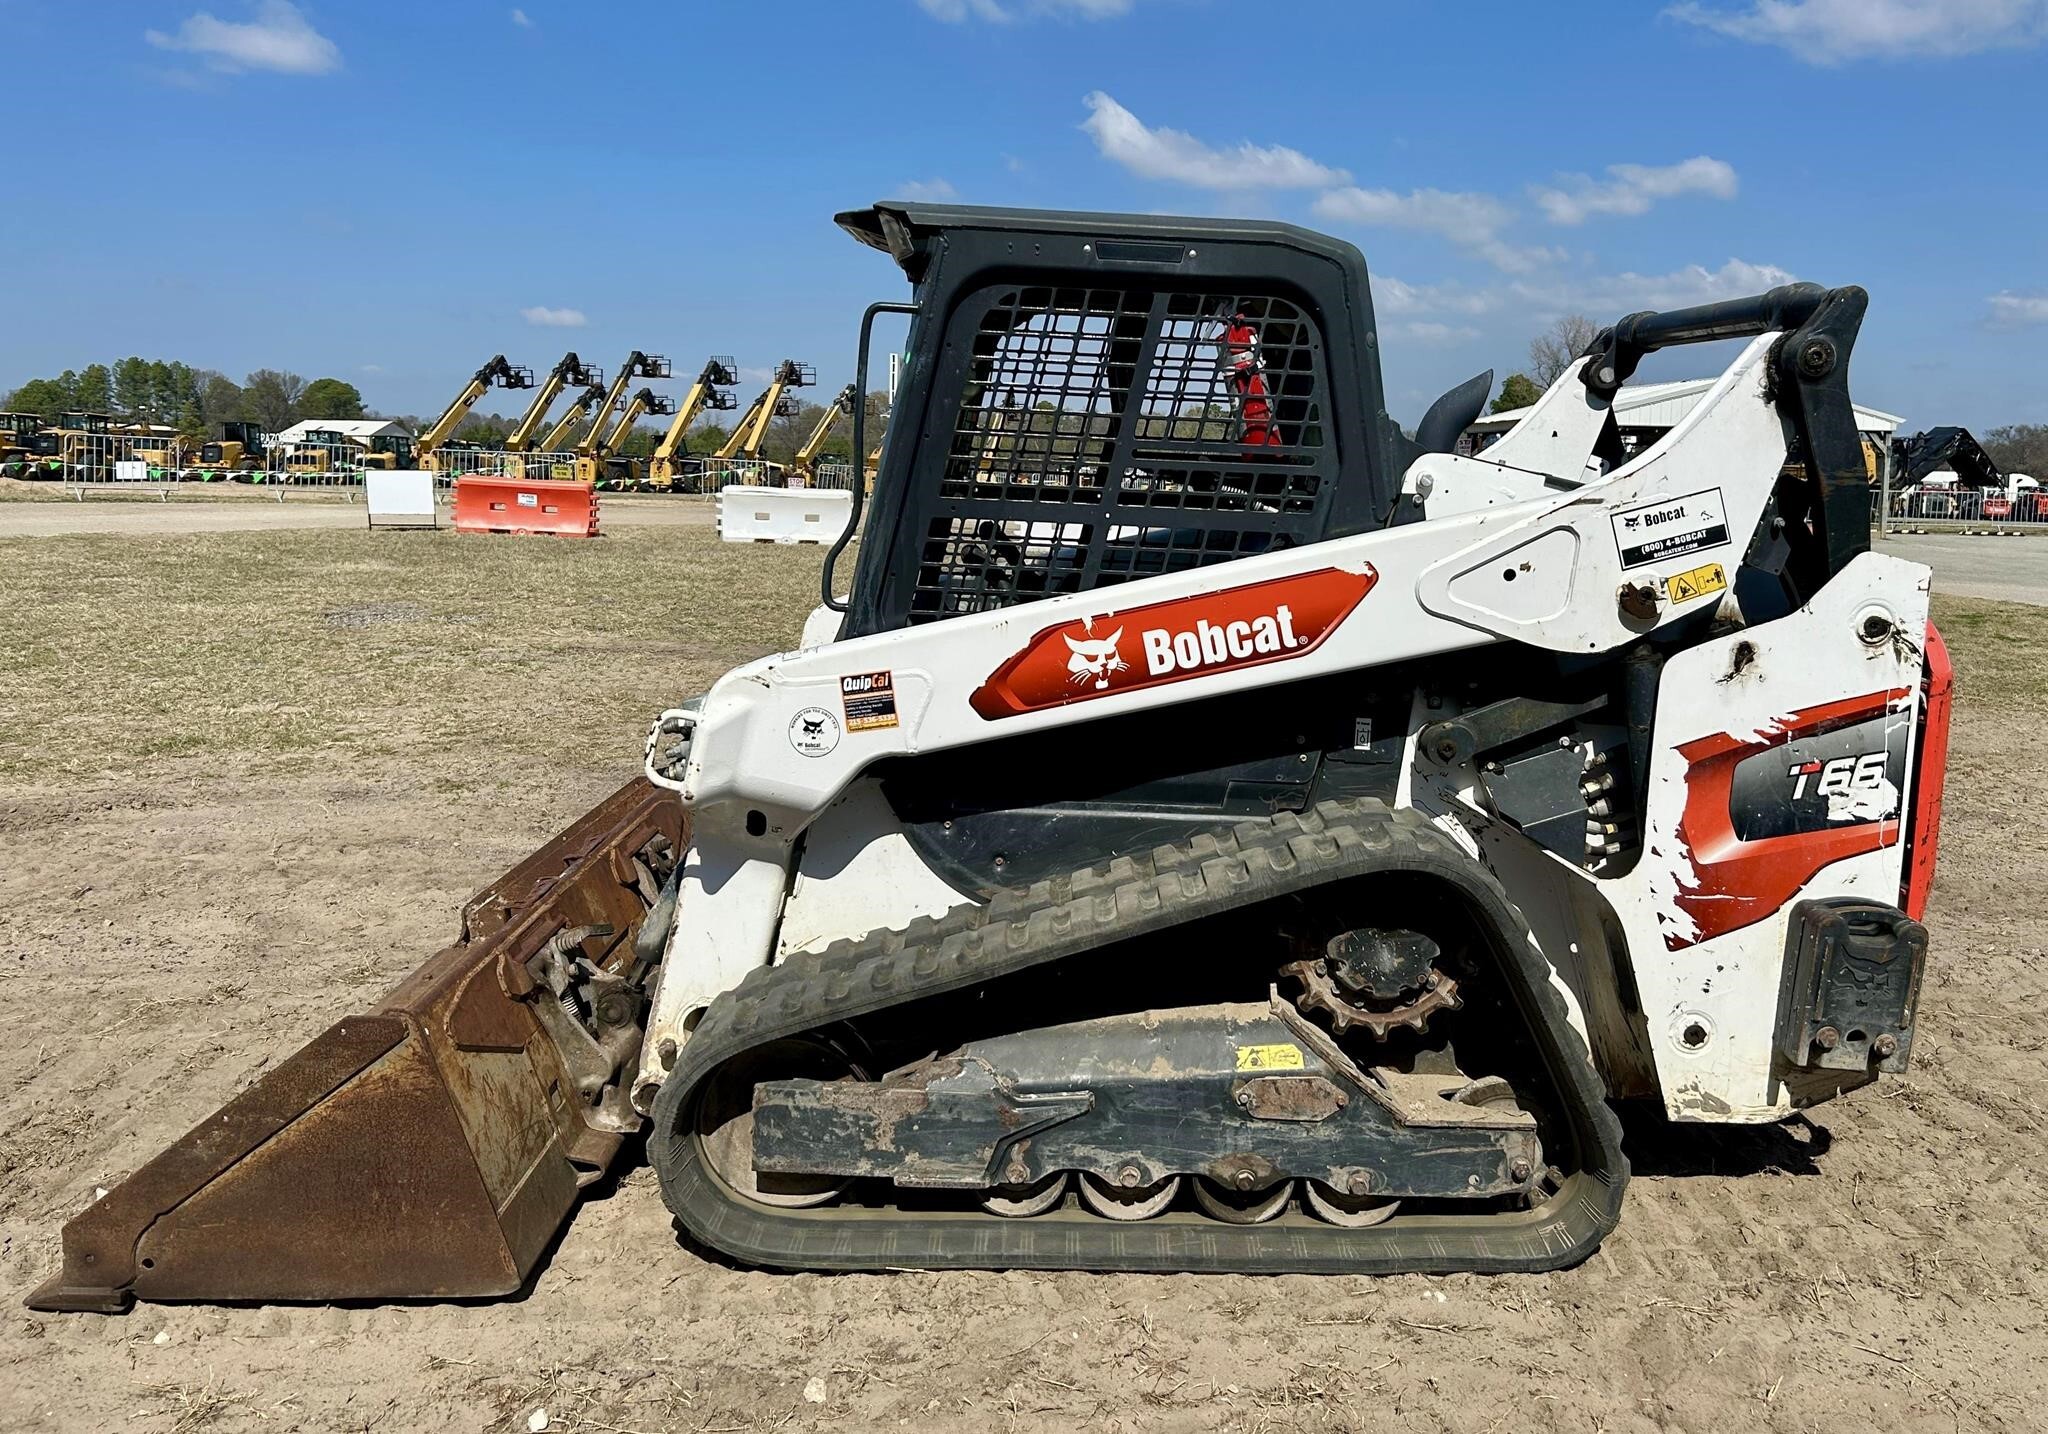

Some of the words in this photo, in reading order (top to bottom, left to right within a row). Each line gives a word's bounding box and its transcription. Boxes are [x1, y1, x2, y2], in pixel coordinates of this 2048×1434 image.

[1644, 505, 1686, 527] Bobcat
[1641, 542, 1664, 554] (800)
[1665, 530, 1707, 547] 4-BOBCAT
[1141, 604, 1300, 676] Bobcat
[844, 673, 889, 691] QuipCal
[1789, 751, 1889, 801] T66
